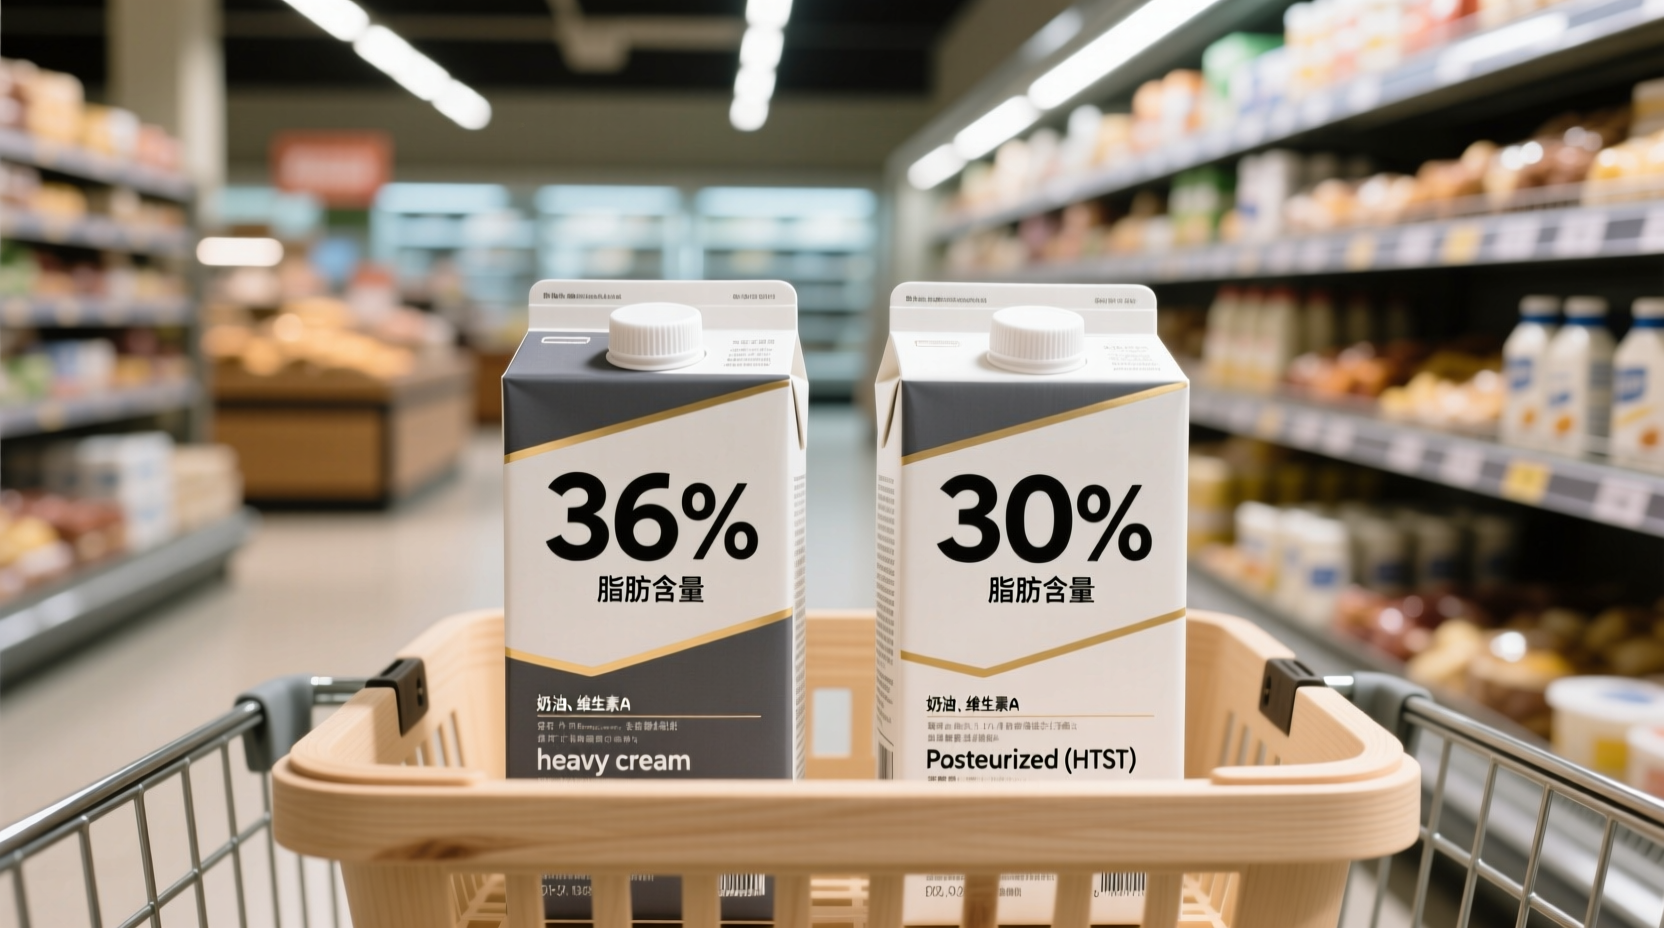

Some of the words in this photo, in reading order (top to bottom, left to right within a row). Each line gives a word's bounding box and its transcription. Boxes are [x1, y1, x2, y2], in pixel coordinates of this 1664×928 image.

[546, 472, 758, 562] 36%
[937, 474, 1152, 564] 30%
[597, 575, 704, 604] 脂肪含量
[988, 576, 1095, 604] 脂肪含量
[537, 747, 609, 776] heavy
[615, 754, 691, 771] cream
[1064, 746, 1136, 774] (HTST)
